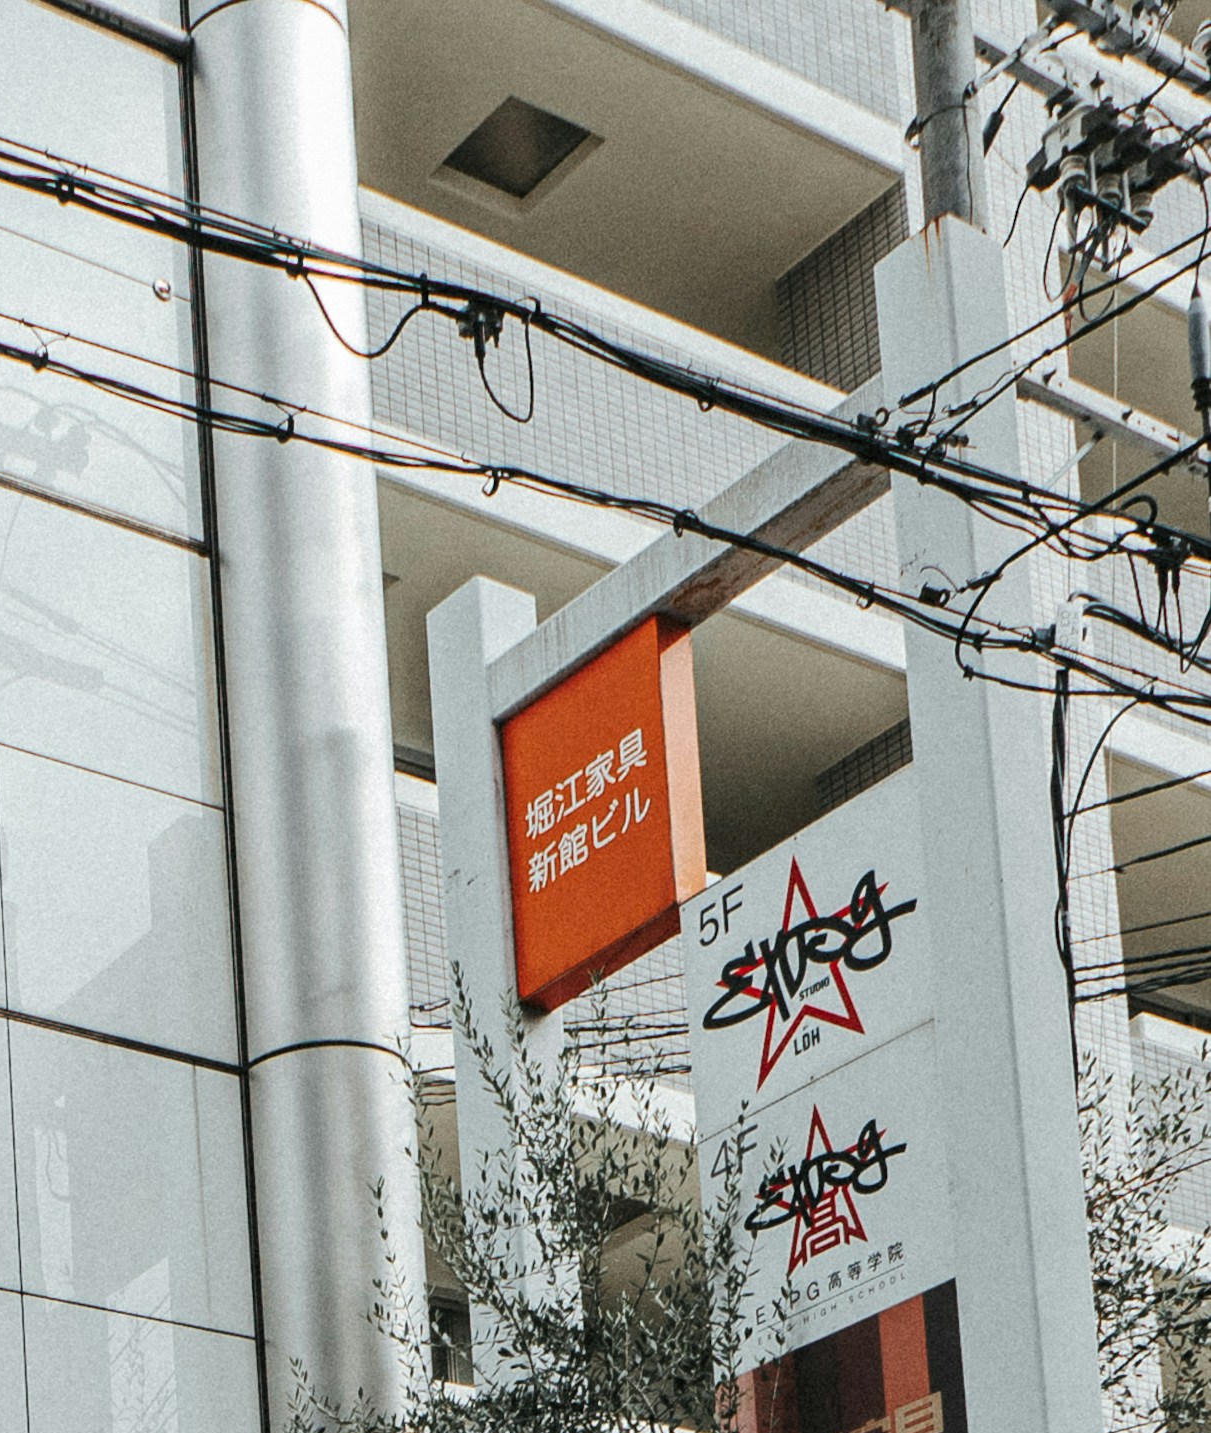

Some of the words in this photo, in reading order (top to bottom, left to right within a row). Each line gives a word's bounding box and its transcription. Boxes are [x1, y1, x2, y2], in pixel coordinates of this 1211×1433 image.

[524, 727, 648, 841] 堀江家具
[528, 787, 651, 894] 新館ビル
[699, 883, 744, 947] 5F
[798, 975, 830, 1002] STUDIO
[793, 1027, 821, 1056] LDH
[847, 1272, 906, 1305] SCHOOL
